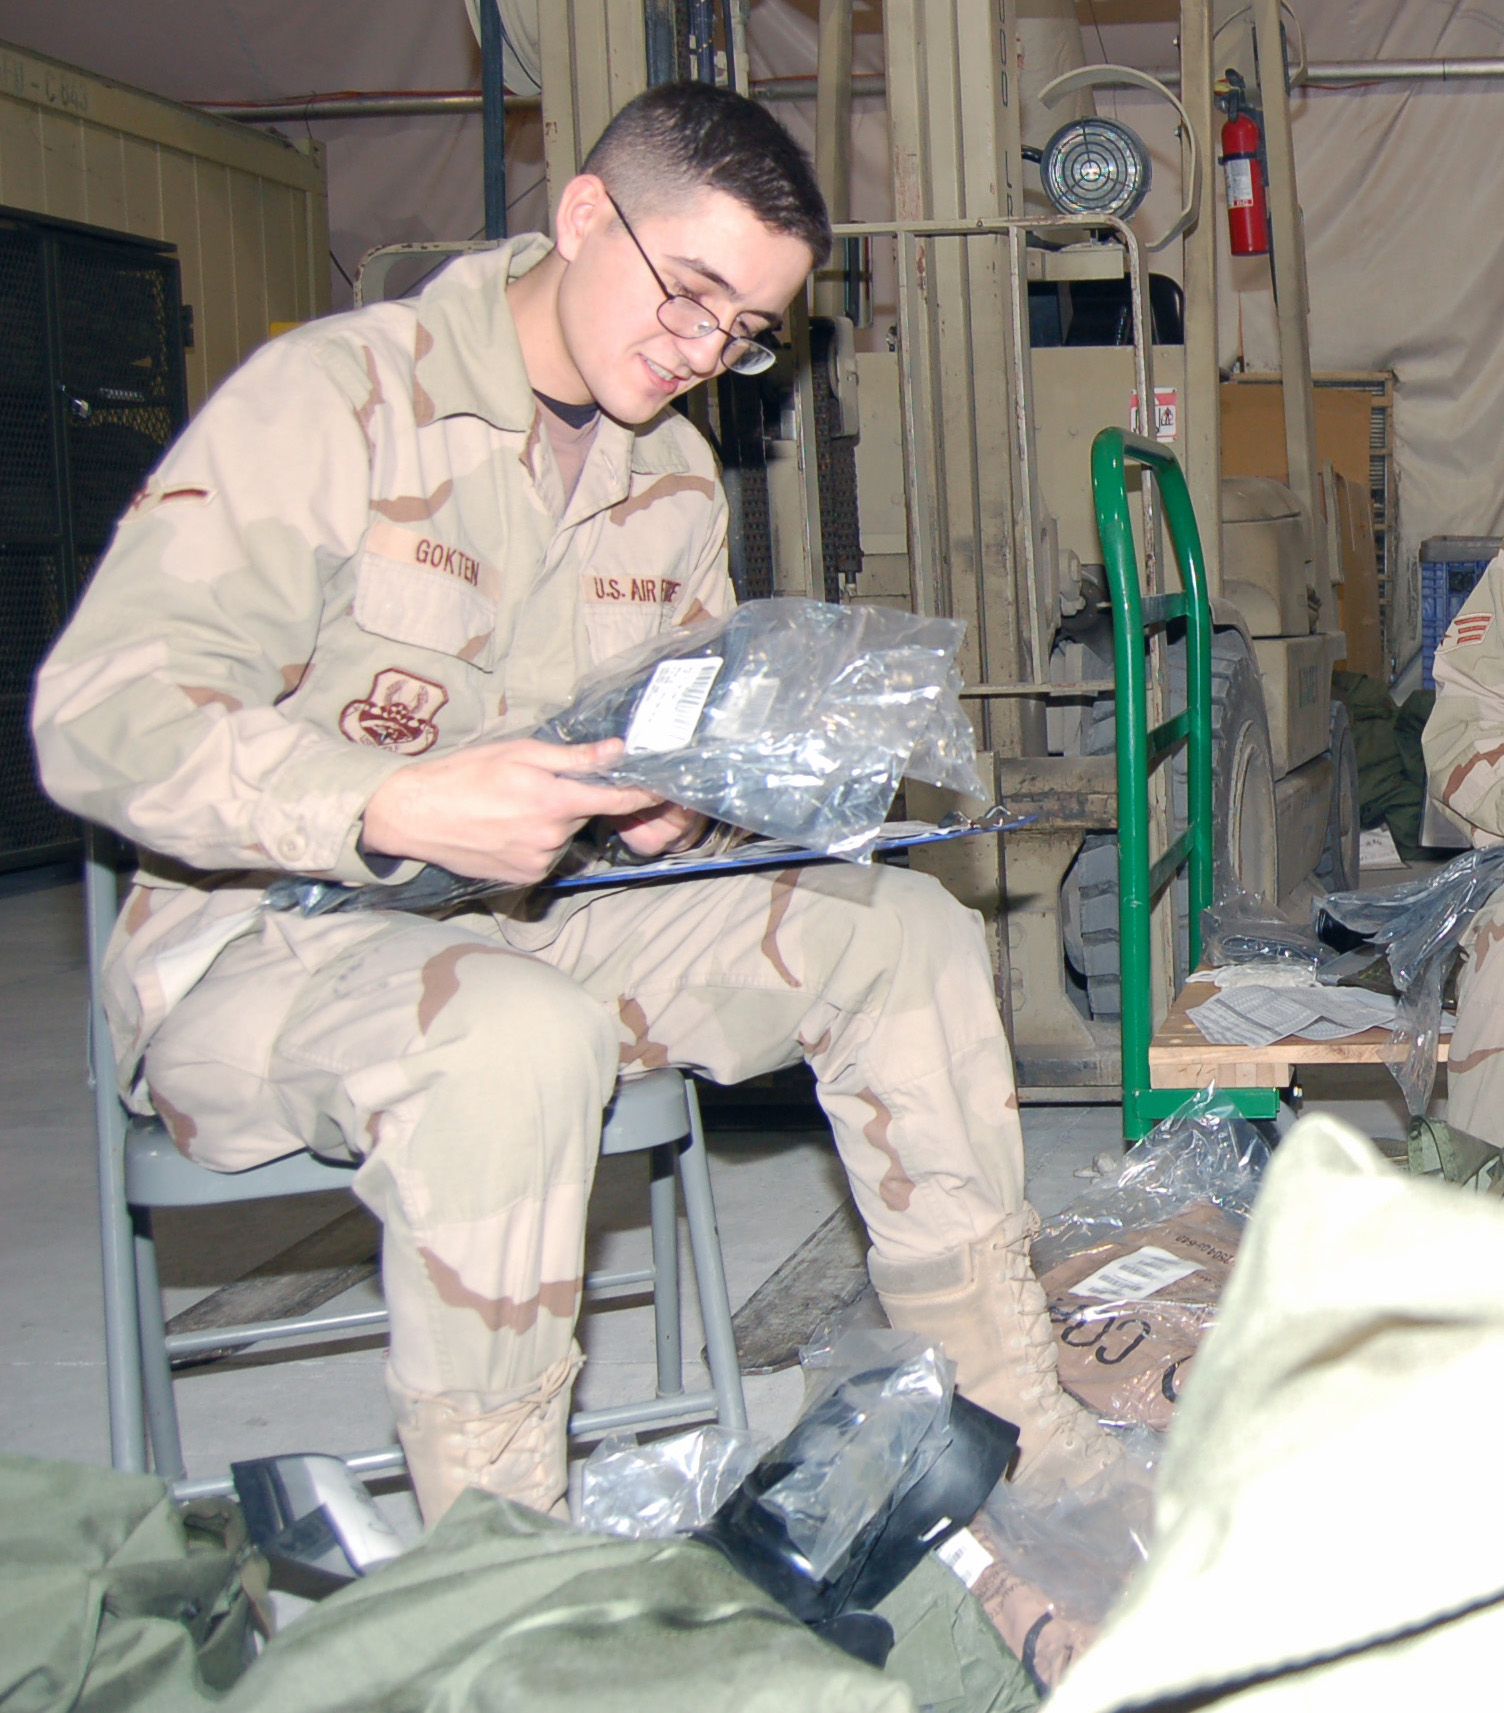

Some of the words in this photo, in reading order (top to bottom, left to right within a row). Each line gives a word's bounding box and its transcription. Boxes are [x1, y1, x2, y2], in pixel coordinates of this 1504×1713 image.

[416, 539, 480, 586] GOKTEN
[594, 577, 626, 599] U.S.
[631, 578, 656, 602] AIR
